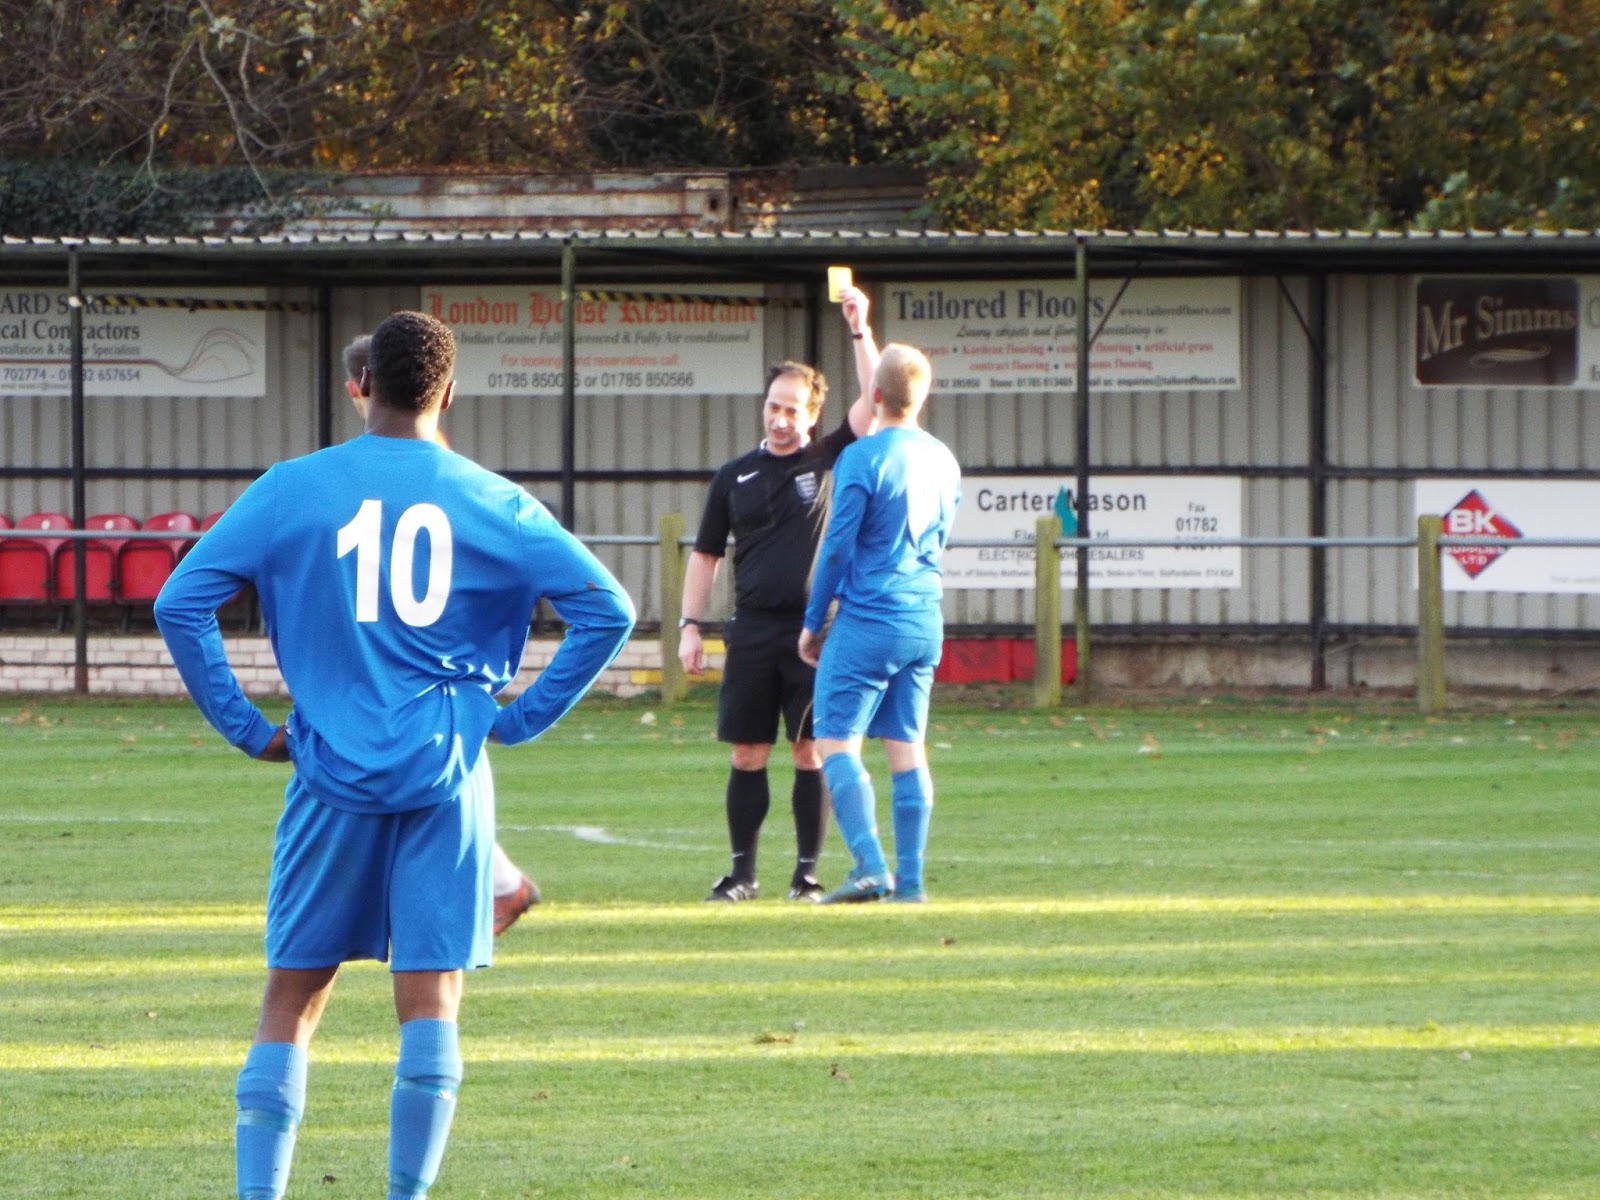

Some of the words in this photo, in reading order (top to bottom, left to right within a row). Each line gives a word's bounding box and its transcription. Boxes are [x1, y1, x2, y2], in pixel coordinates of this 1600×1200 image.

[427, 292, 518, 324] London
[893, 289, 1006, 320] Tailored
[1017, 288, 1105, 318] Floos
[33, 319, 140, 340] Conractors
[1421, 301, 1468, 361] Mr
[1475, 296, 1577, 340] Simms
[488, 373, 527, 388] 01785
[584, 377, 597, 387] or
[601, 372, 641, 387] 01785
[977, 488, 1055, 511] Carter
[1451, 509, 1499, 534] BK
[336, 499, 453, 628] 10
